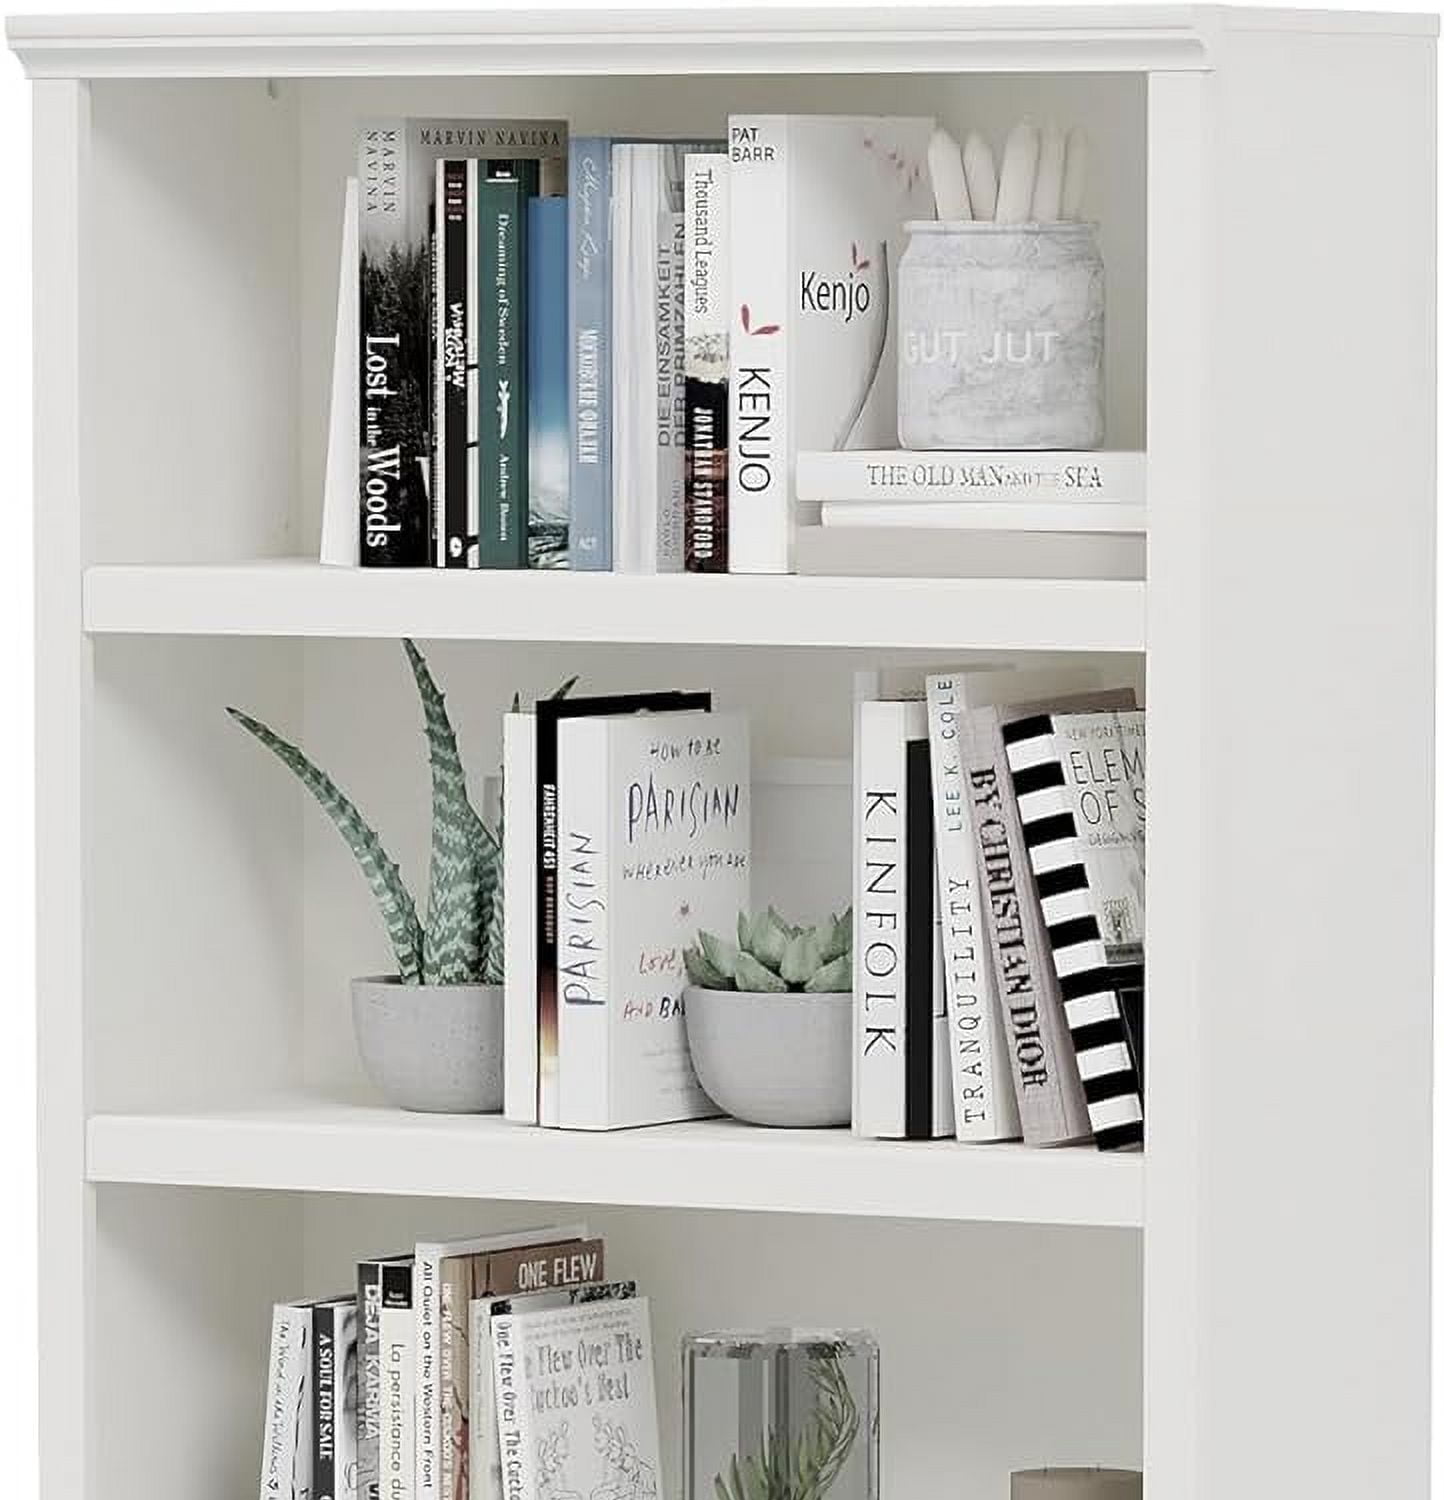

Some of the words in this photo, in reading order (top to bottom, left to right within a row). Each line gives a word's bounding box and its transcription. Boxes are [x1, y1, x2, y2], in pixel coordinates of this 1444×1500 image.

[421, 129, 486, 147] MARVIN
[495, 129, 561, 147] NAVINA
[732, 127, 758, 143] PAT
[732, 147, 775, 163] BARR
[367, 131, 378, 213] NAVINA
[382, 131, 397, 213] MARVIN
[694, 169, 713, 247] Thousand
[496, 213, 510, 286] Dreaming
[497, 289, 510, 305] of
[690, 250, 713, 314] Leagues
[800, 270, 870, 323] Kenjo
[497, 306, 510, 365] Sweden
[657, 244, 671, 398] EINSAMKEIT
[366, 333, 399, 399] Lost
[904, 330, 968, 366] GUT
[981, 330, 1059, 364] JUT
[657, 406, 671, 447] DIE
[738, 367, 771, 493] KENJO
[366, 445, 399, 547] Woods
[867, 464, 907, 486] THE
[912, 464, 954, 486] OLD
[959, 464, 1003, 487] MAN
[1064, 465, 1104, 488] SEA
[936, 678, 956, 739] COLE
[628, 770, 739, 844] PARISIAN
[971, 765, 1002, 809] BY
[1081, 789, 1119, 825] OF
[944, 790, 963, 833] LEE
[564, 832, 606, 1006] PARISIAN
[864, 790, 898, 1057] KINFOLK
[978, 817, 1034, 995] CHRISTIAN
[948, 876, 987, 1123] TRANQUILITY
[1010, 1003, 1048, 1088] DIOR
[423, 1261, 434, 1281] All
[518, 1260, 548, 1291] ONE
[553, 1252, 598, 1286] FLEW
[422, 1285, 434, 1326] Quiet
[319, 1333, 334, 1347] A
[391, 1343, 406, 1363] La
[424, 1332, 434, 1350] on
[496, 1321, 512, 1348] One
[615, 1332, 642, 1364] The
[319, 1348, 334, 1390] SOUL
[423, 1354, 434, 1378] the
[498, 1352, 514, 1387] Flew
[319, 1391, 334, 1420] FOR
[364, 1354, 381, 1441] KARMA
[423, 1384, 434, 1445] Western
[501, 1391, 518, 1424] Over
[319, 1422, 334, 1460] SALE
[388, 1370, 407, 1472] persistance
[505, 1430, 521, 1457] The
[423, 1450, 434, 1488] Front
